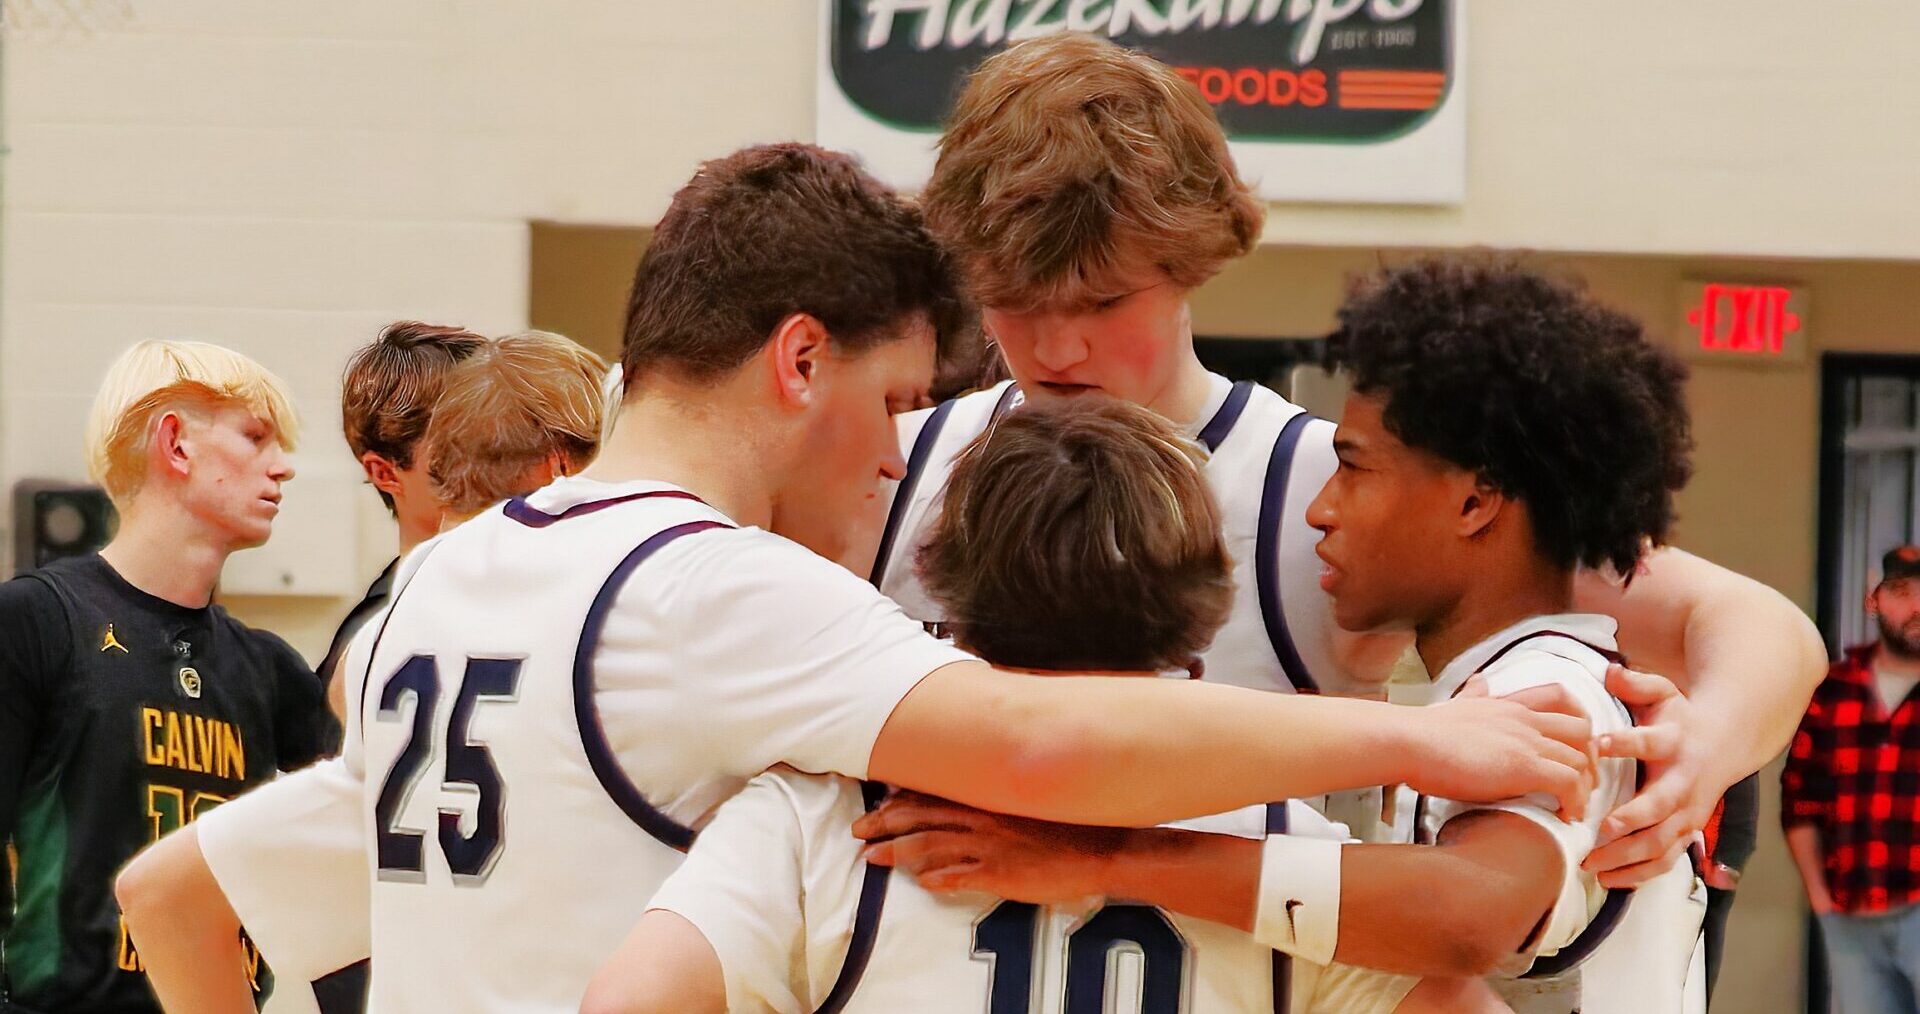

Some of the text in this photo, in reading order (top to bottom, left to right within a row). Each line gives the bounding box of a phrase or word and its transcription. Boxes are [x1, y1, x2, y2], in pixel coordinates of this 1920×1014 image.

[1701, 283, 1791, 353] EXIT
[143, 707, 245, 781] CALVIN
[375, 650, 530, 887] 25
